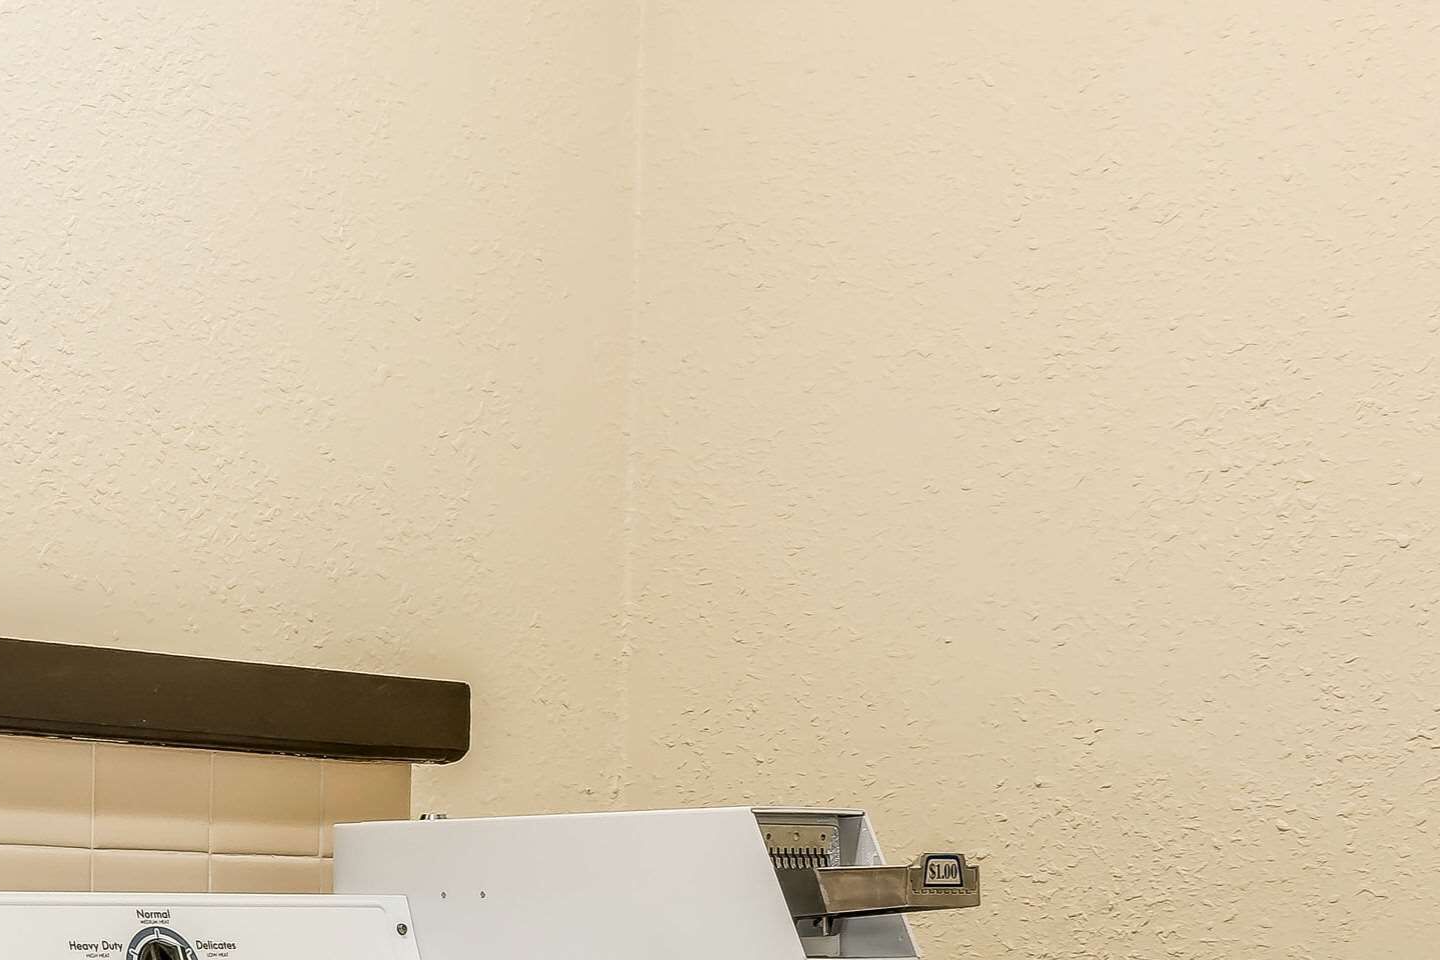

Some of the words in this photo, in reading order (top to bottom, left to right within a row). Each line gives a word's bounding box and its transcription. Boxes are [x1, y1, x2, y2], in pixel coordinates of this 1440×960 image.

[928, 863, 958, 880] $1.00
[135, 909, 171, 919] Normal
[68, 940, 100, 952] Heavy
[101, 940, 124, 952] Duty
[195, 939, 237, 950] Delicates
